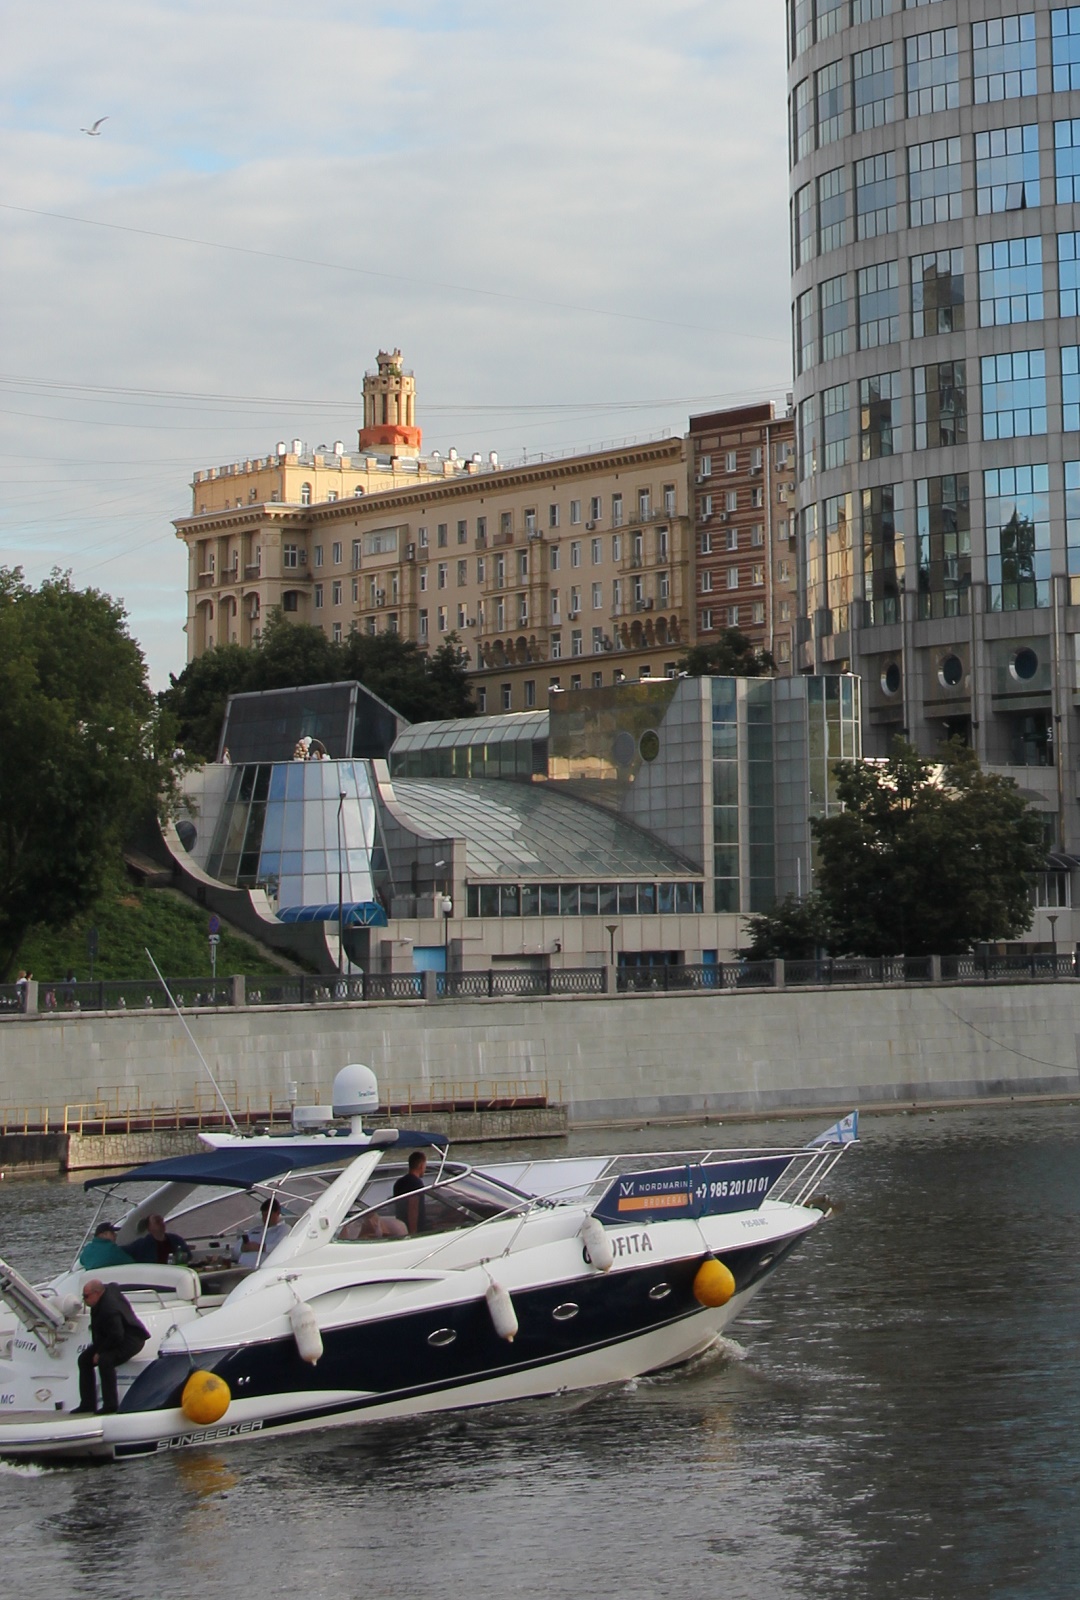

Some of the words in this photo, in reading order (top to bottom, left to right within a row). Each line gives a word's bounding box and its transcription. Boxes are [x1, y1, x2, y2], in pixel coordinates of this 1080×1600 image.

[710, 1181, 728, 1198] 985
[729, 1179, 746, 1196] 201
[747, 1178, 757, 1193] 01
[758, 1176, 769, 1192] 01
[644, 1195, 692, 1208] BROKERAG
[156, 1420, 264, 1451] SUNSEEKER
